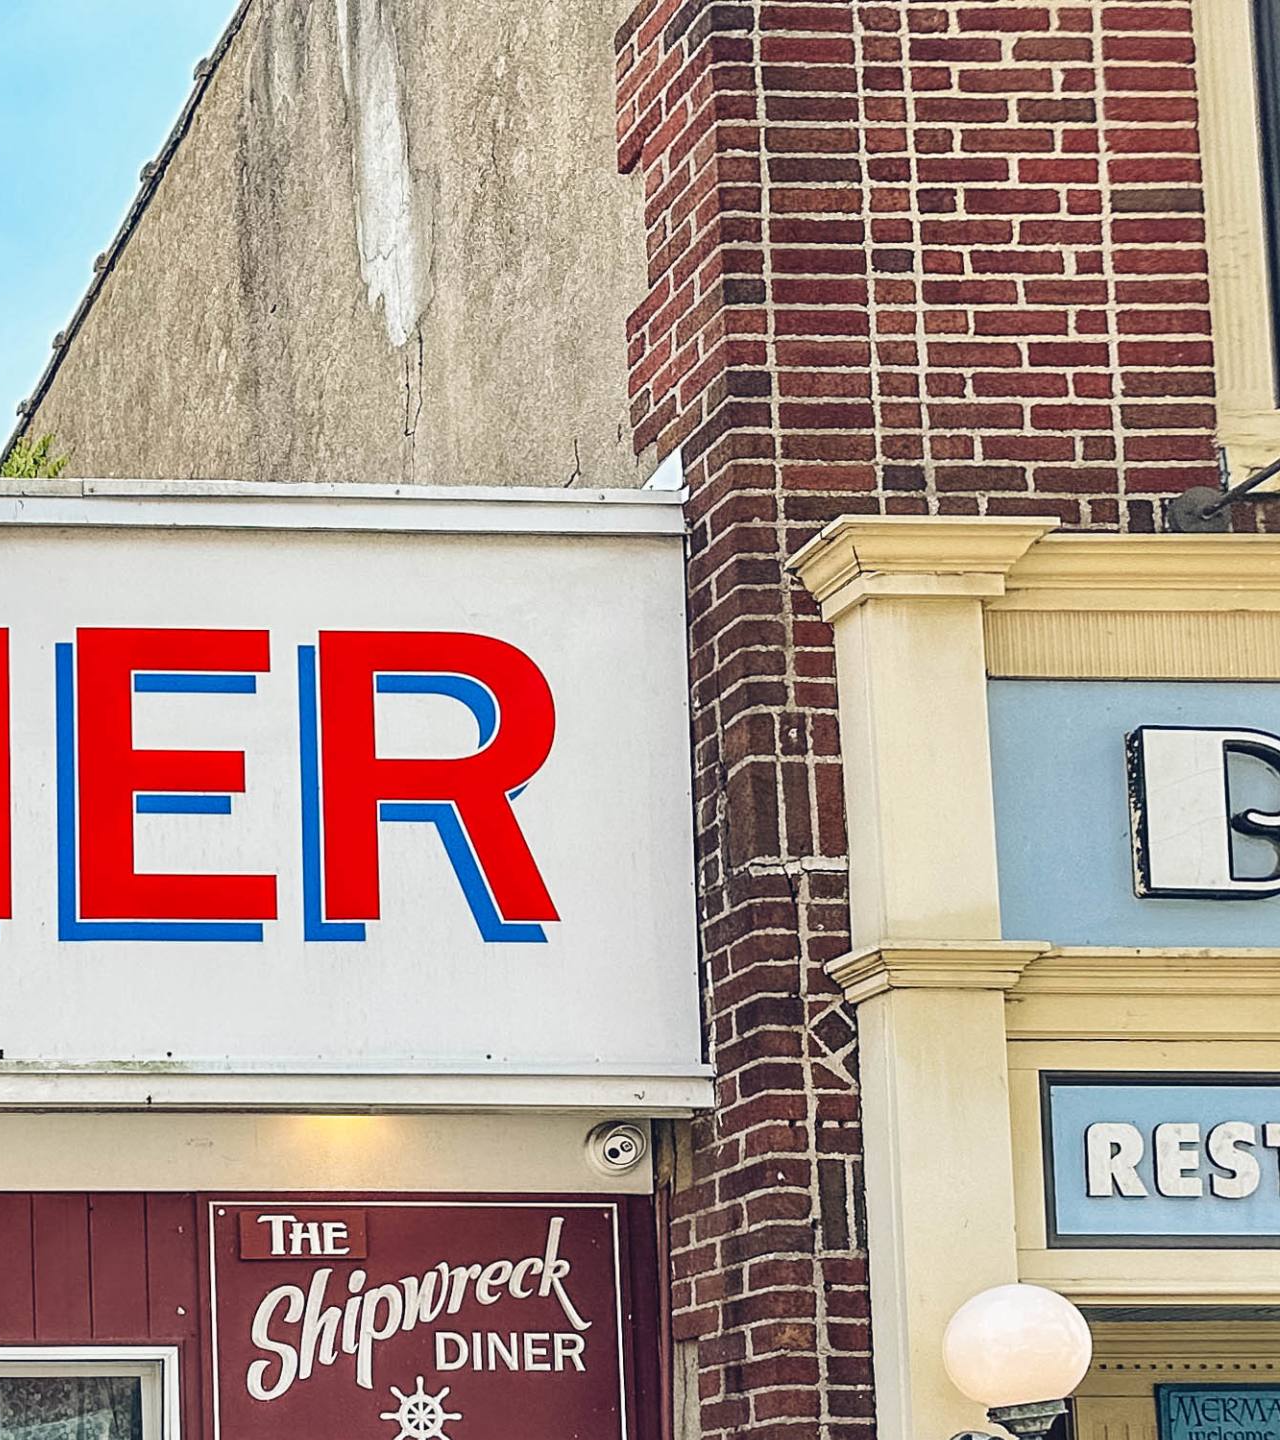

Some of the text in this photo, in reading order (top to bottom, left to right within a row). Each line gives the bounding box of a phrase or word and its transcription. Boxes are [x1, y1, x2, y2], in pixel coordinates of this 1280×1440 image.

[257, 1214, 350, 1255] THE
[246, 1217, 592, 1401] Shipwreck
[435, 1331, 587, 1372] DINER
